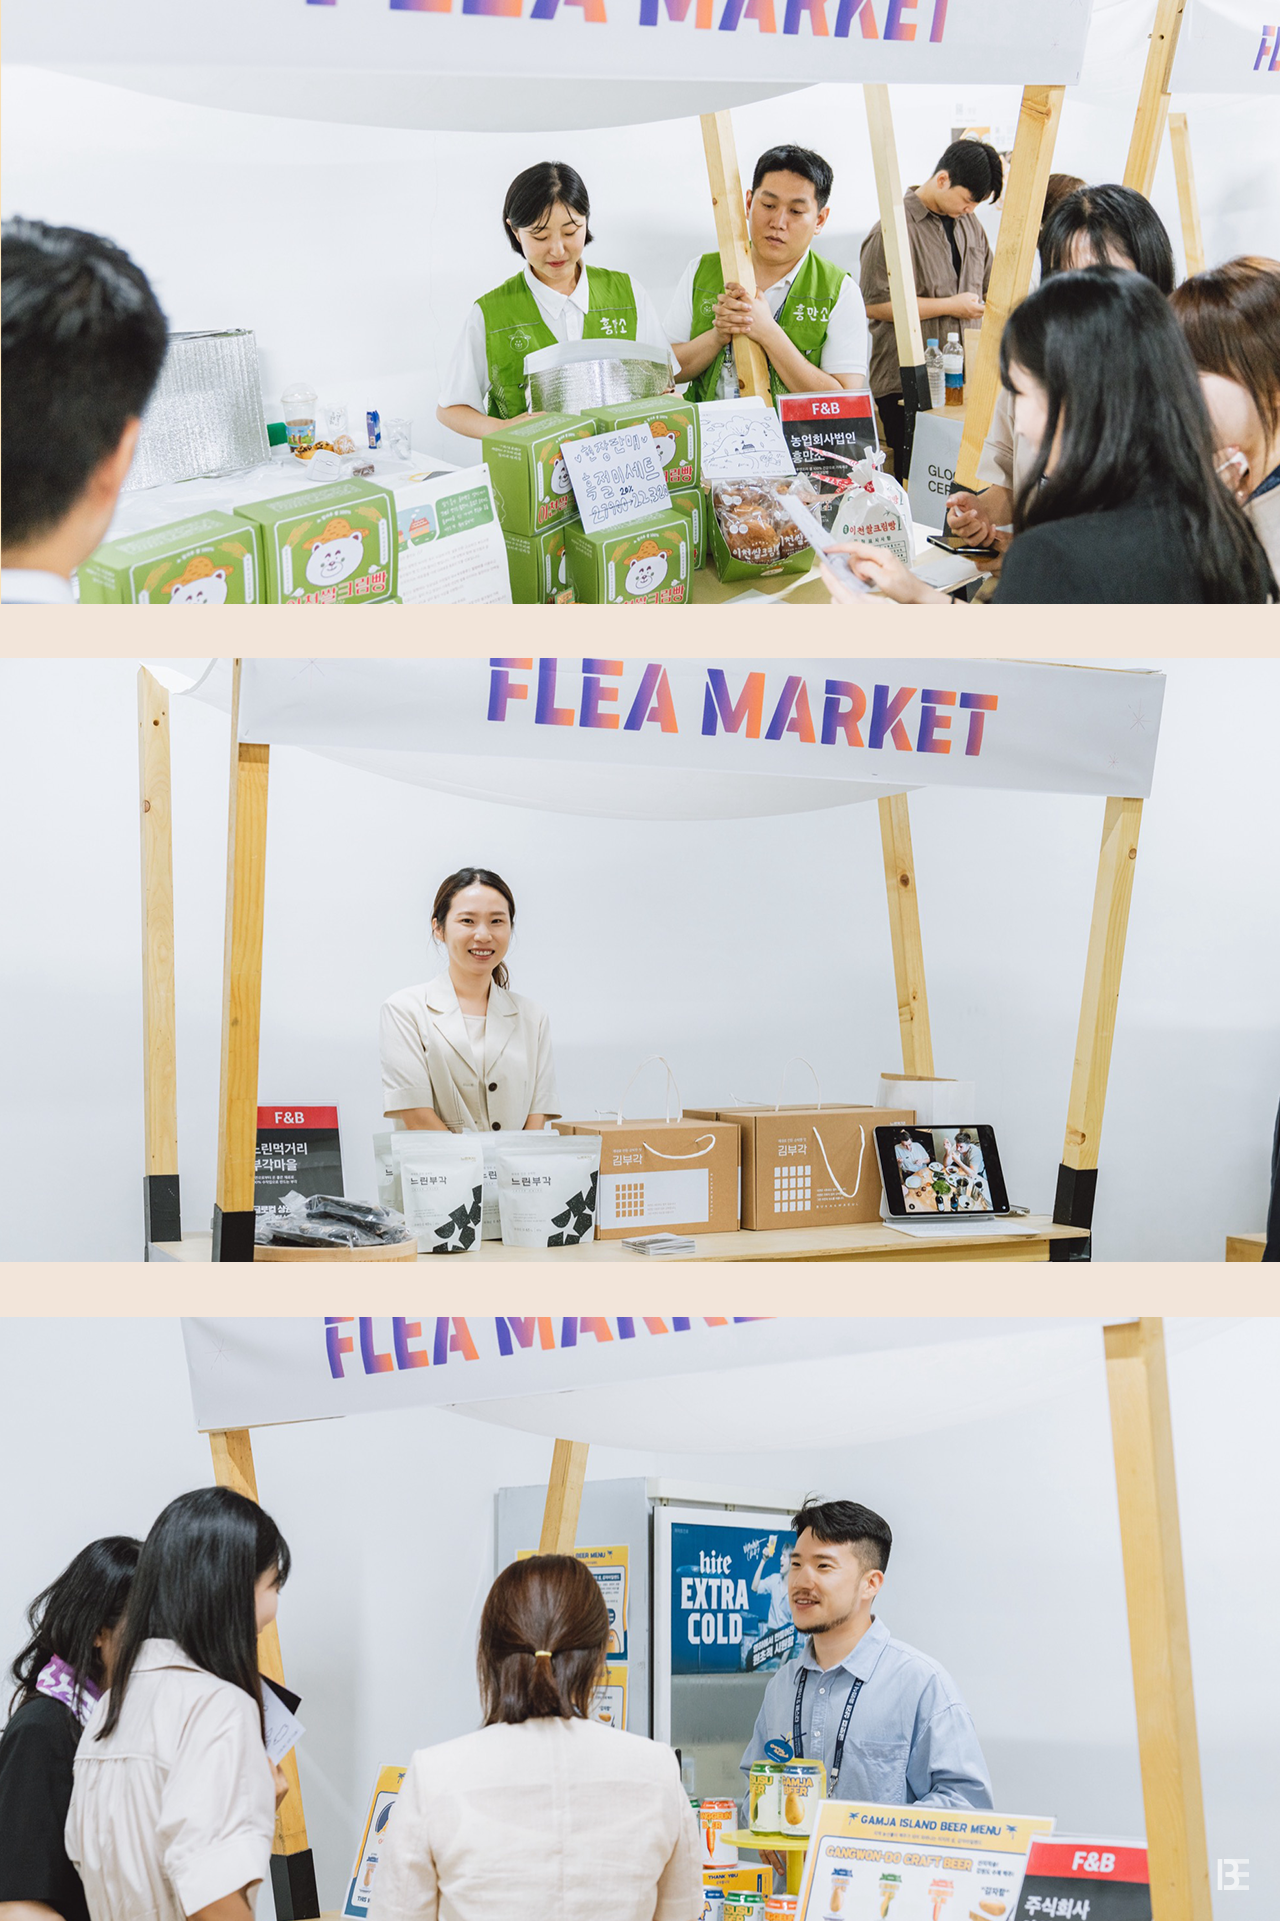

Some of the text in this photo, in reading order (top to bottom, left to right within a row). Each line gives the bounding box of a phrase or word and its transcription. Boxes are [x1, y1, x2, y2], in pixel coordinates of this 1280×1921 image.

[811, 401, 841, 416] F&B
[790, 432, 856, 448] 농업회사법인
[928, 464, 955, 481] GLO
[619, 485, 634, 495] 20%
[850, 520, 896, 536] 이천쌀크림빵
[487, 658, 999, 757] FLEA MARKET
[274, 1111, 305, 1124] F&B
[778, 1144, 808, 1157] 김부각
[612, 1153, 643, 1167] 김부각
[411, 1176, 447, 1186] 느린부각
[511, 1176, 551, 1187] 느린부각
[324, 1317, 480, 1379] FLEA
[699, 1549, 732, 1575] hite
[681, 1577, 749, 1610] EXTRA
[687, 1612, 743, 1645] COLD
[861, 1815, 1002, 1836] GAMJA ISLAND BEER MENU
[826, 1845, 973, 1872] GANGWON-DO CRAFT BEER
[1072, 1851, 1116, 1873] F&B
[1024, 1895, 1091, 1920] 주식회사
